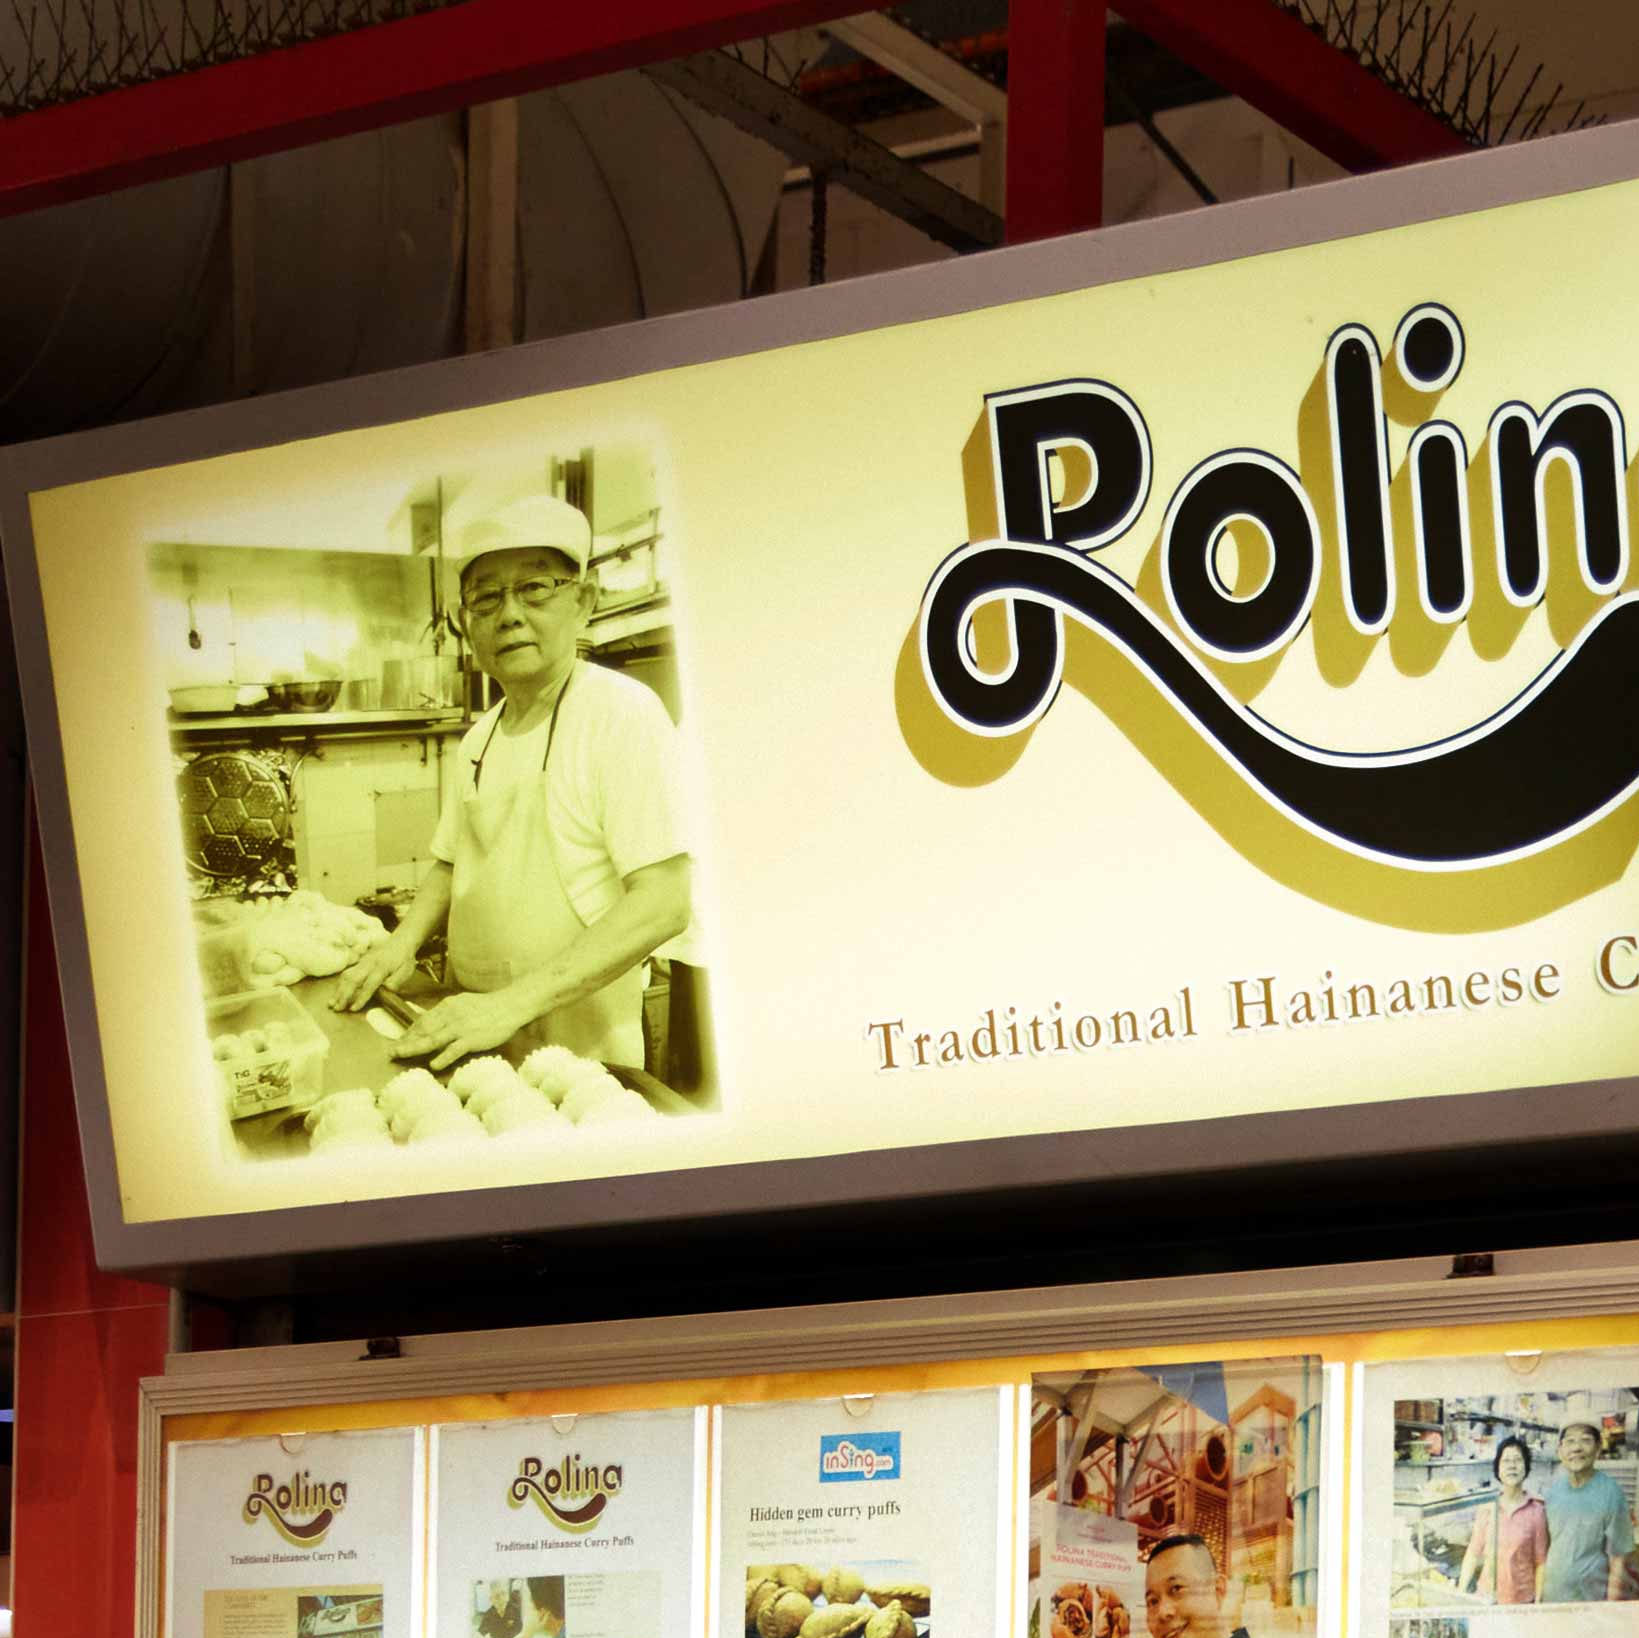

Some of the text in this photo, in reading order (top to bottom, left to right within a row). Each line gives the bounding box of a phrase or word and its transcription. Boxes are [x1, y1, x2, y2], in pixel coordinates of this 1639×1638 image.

[866, 984, 1198, 1073] Traditional
[1230, 955, 1560, 1035] Hainanese
[243, 1469, 347, 1547] Rolina
[507, 1453, 623, 1534] Rolina
[749, 1501, 901, 1522] Hidden gem curry puffs
[230, 1549, 357, 1565] Traditional Hainanese Curry Puffs
[495, 1535, 634, 1552] Traditional Hainanese Curry Puffs
